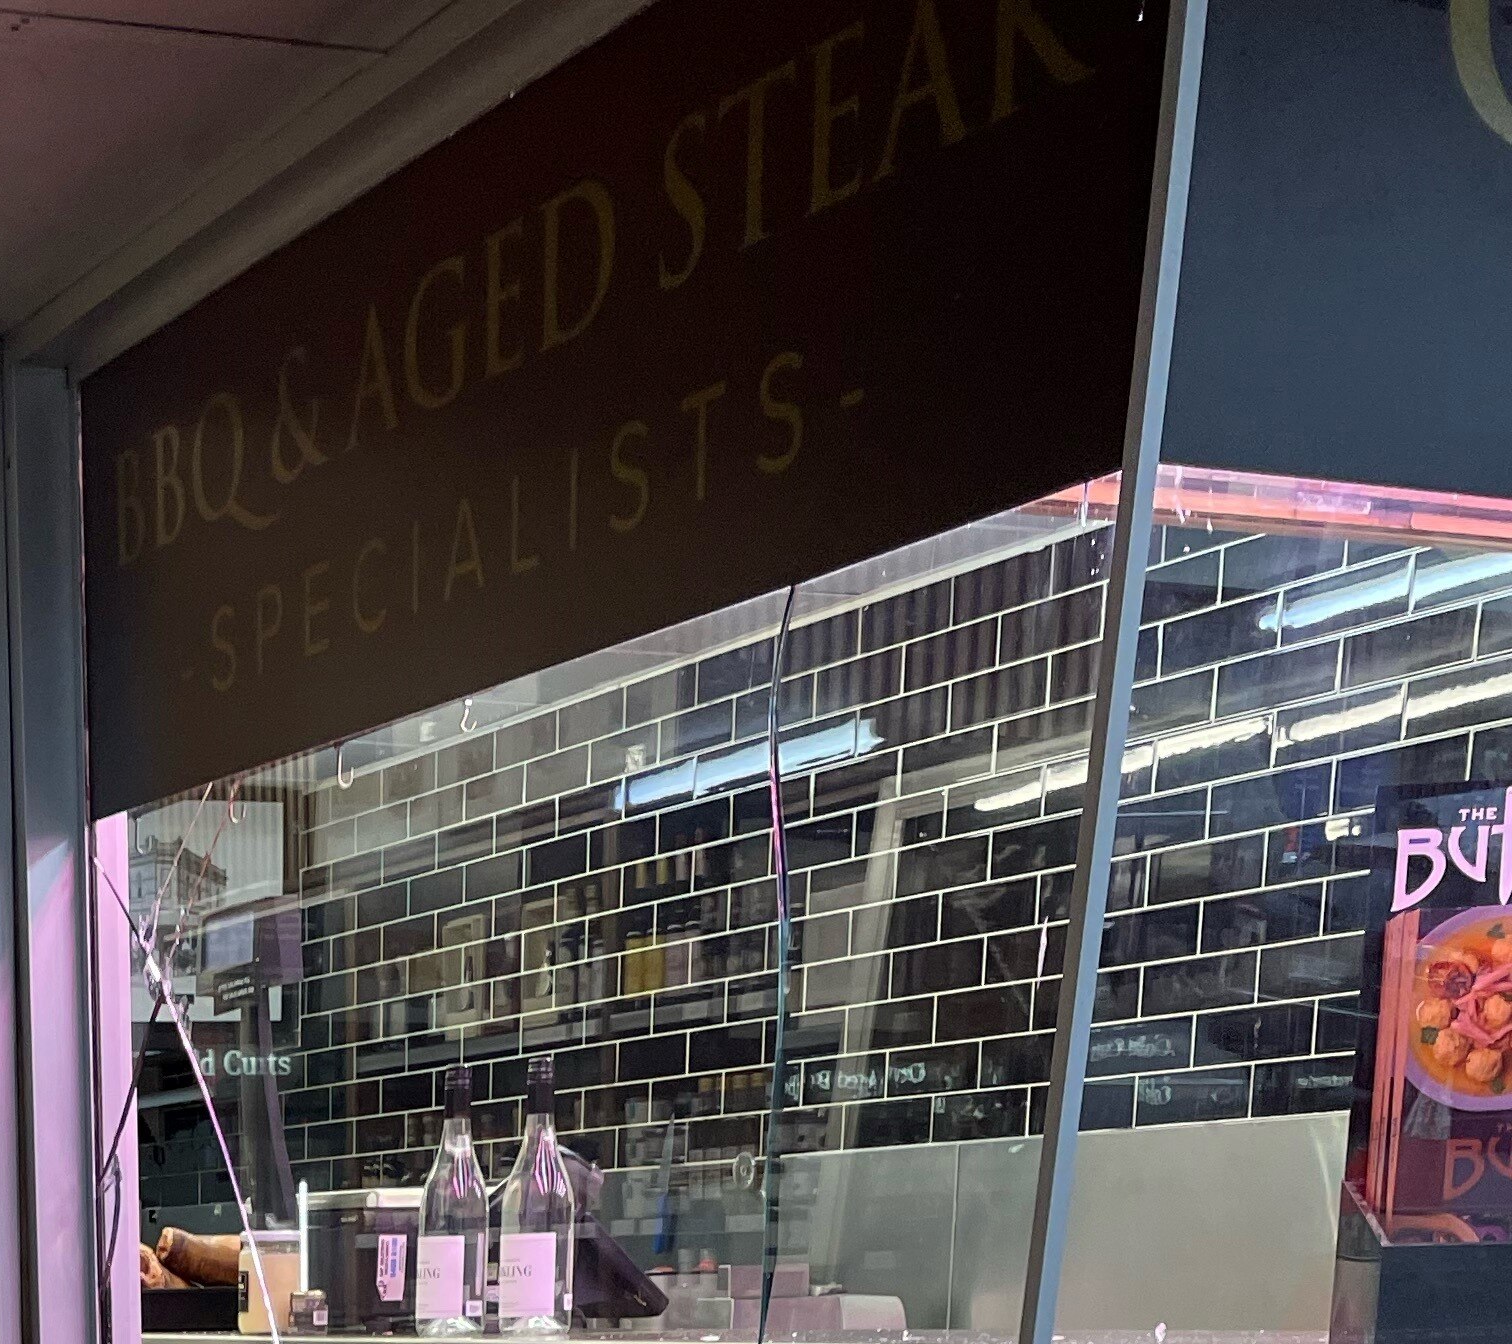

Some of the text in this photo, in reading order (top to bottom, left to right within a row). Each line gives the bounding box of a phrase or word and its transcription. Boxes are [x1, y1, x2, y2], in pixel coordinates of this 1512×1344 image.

[118, 392, 278, 567] BBQ
[271, 347, 329, 485] &
[347, 179, 615, 452] AGED
[1459, 807, 1497, 822] THE
